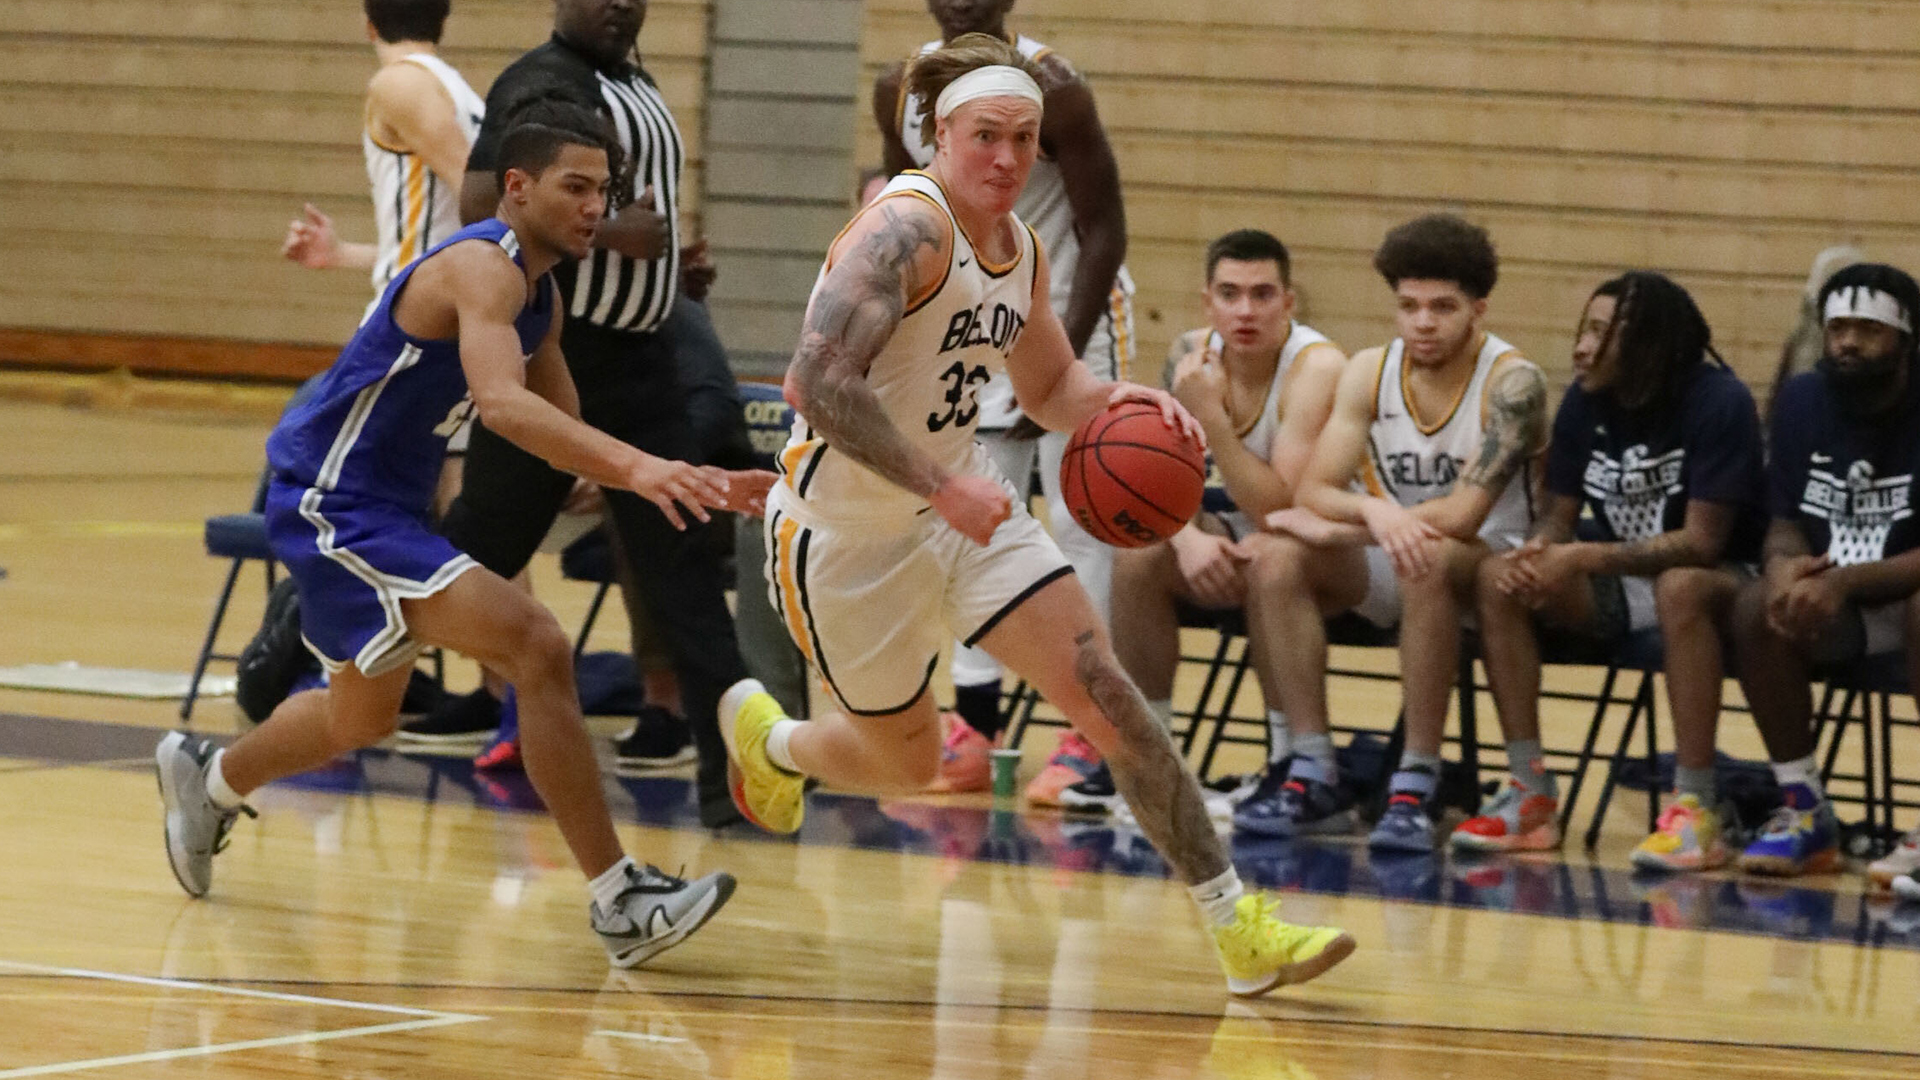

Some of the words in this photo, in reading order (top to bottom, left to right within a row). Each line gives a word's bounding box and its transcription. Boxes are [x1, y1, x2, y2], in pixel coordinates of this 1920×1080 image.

[937, 303, 1026, 359] BELOIT
[743, 400, 791, 425] OIT
[927, 360, 991, 432] 33
